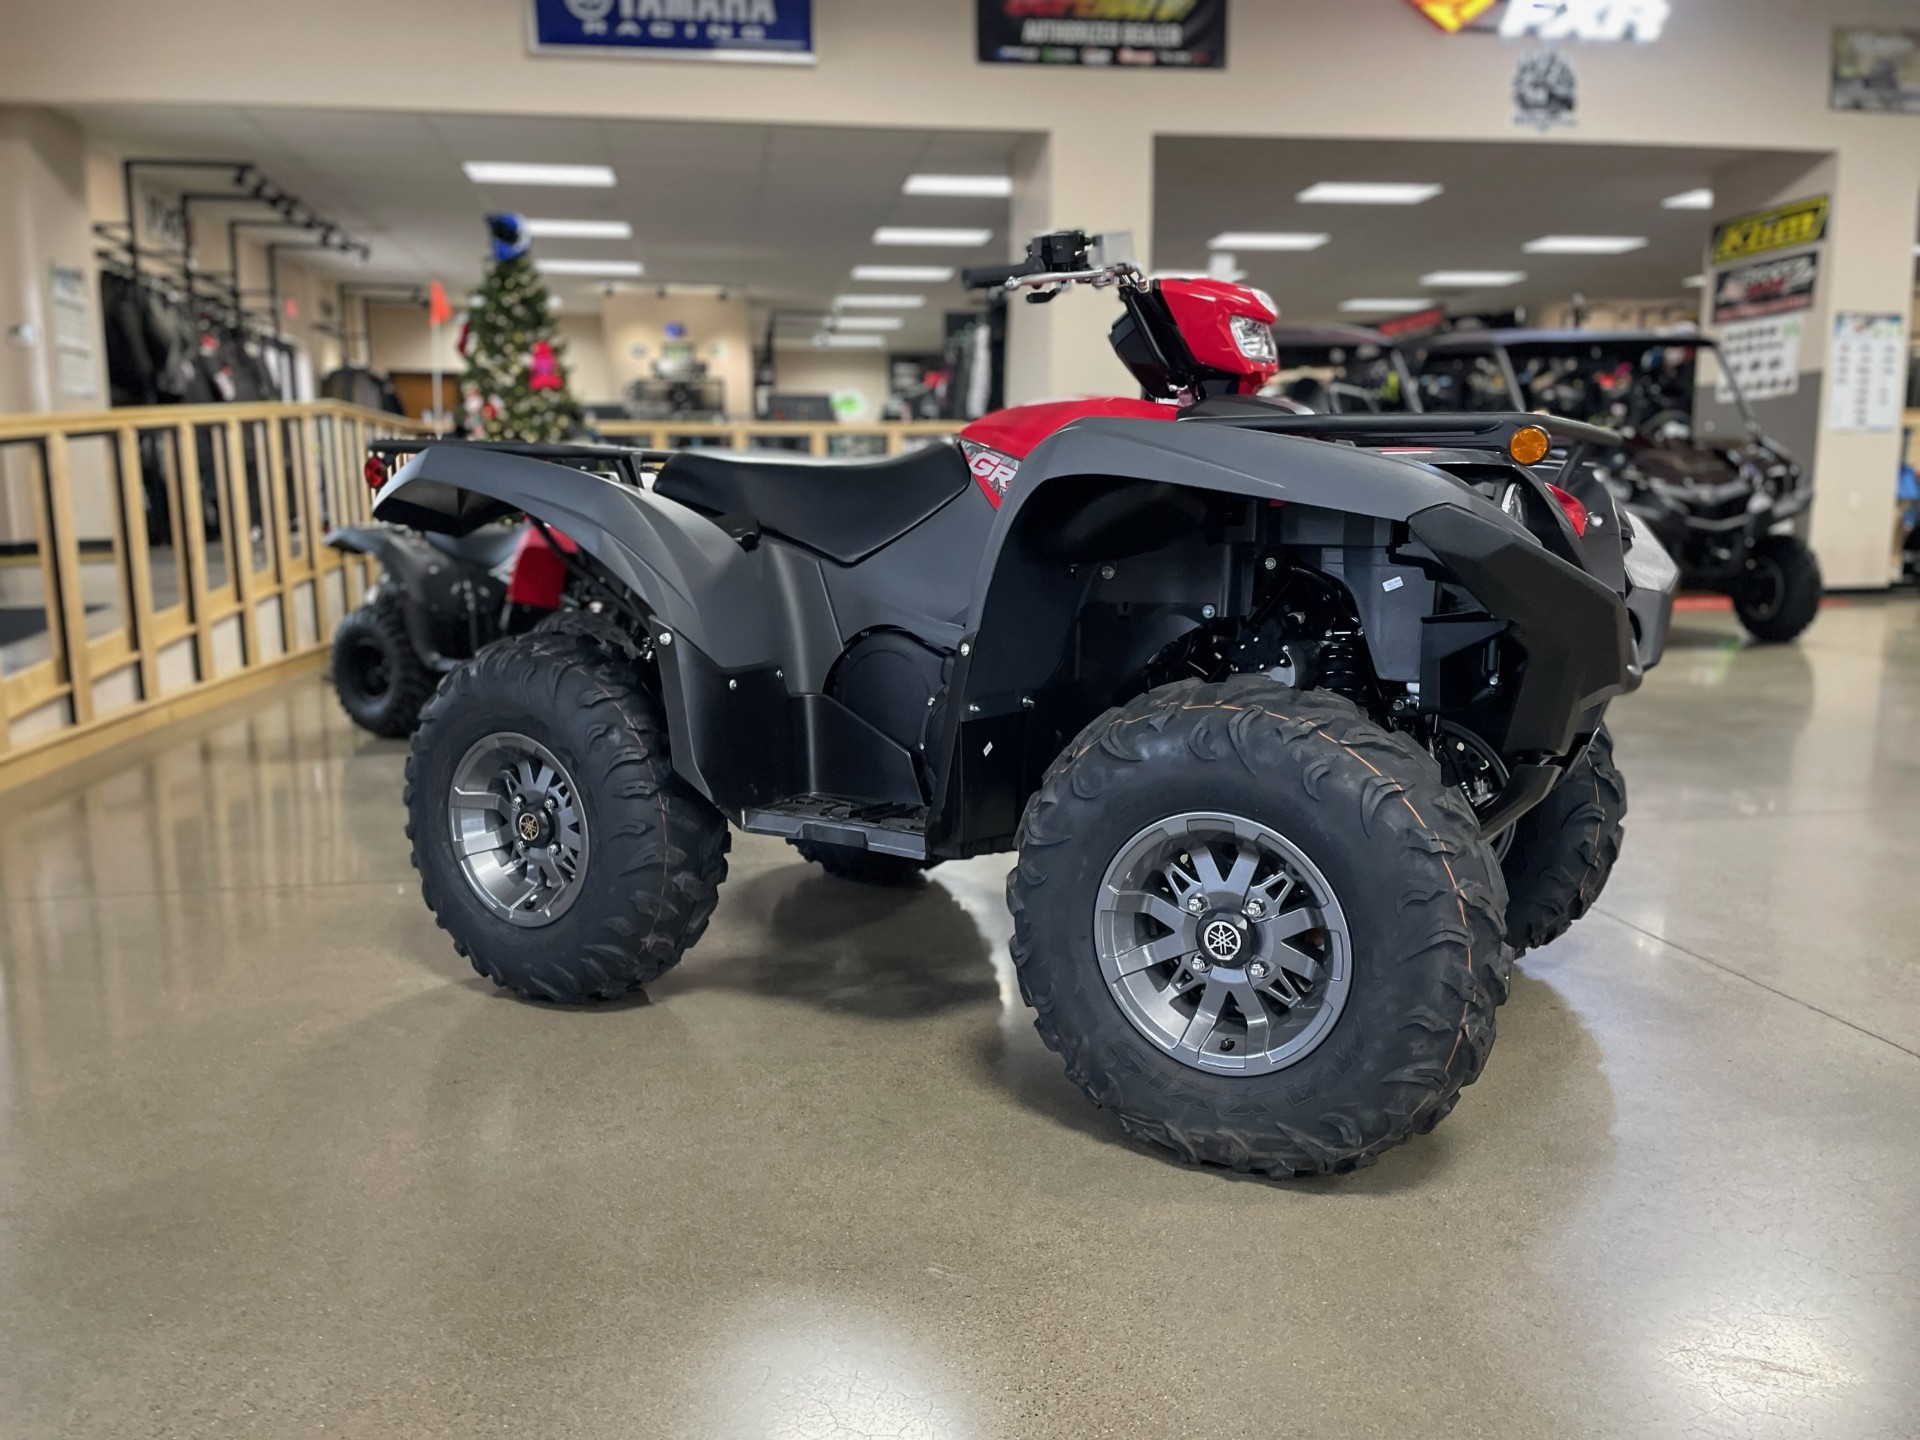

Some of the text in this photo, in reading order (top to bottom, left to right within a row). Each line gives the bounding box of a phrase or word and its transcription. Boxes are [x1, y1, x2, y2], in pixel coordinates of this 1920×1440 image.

[581, 19, 767, 41] RACING
[1021, 18, 1183, 48] AUTHORIZED DEALER
[1500, 0, 1670, 41] FXR
